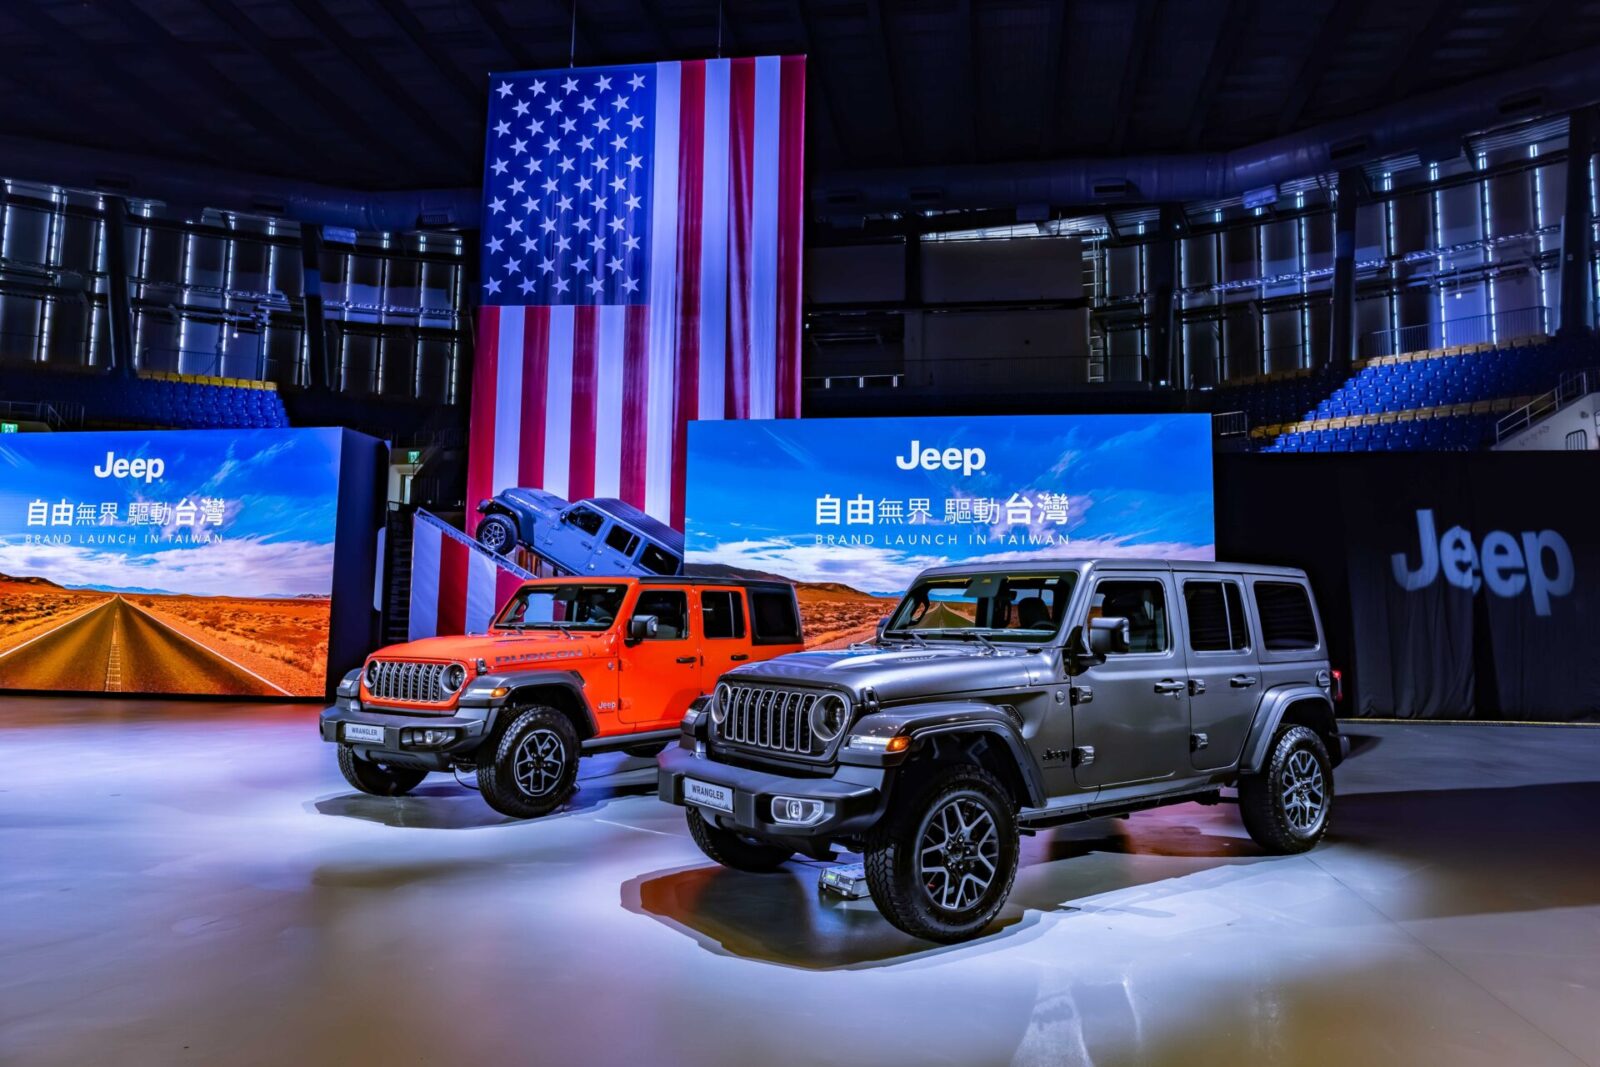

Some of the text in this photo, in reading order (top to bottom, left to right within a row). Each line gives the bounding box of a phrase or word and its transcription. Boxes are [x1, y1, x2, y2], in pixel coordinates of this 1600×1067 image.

[94, 452, 165, 483] Jeep
[896, 440, 986, 476] Jeep
[26, 498, 225, 526] 自由無界 驅動台灣
[815, 492, 1069, 526] 自由無界 驅動台灣
[25, 534, 223, 544] BRAND LAUNCH IN TAIWAN
[815, 534, 1069, 545] BRAND LAUNCH IN TAIWAN
[1391, 508, 1575, 616] Jeep
[598, 702, 617, 710] Jeep
[351, 727, 377, 736] WRANGLER
[691, 784, 724, 801] WRANGLER
